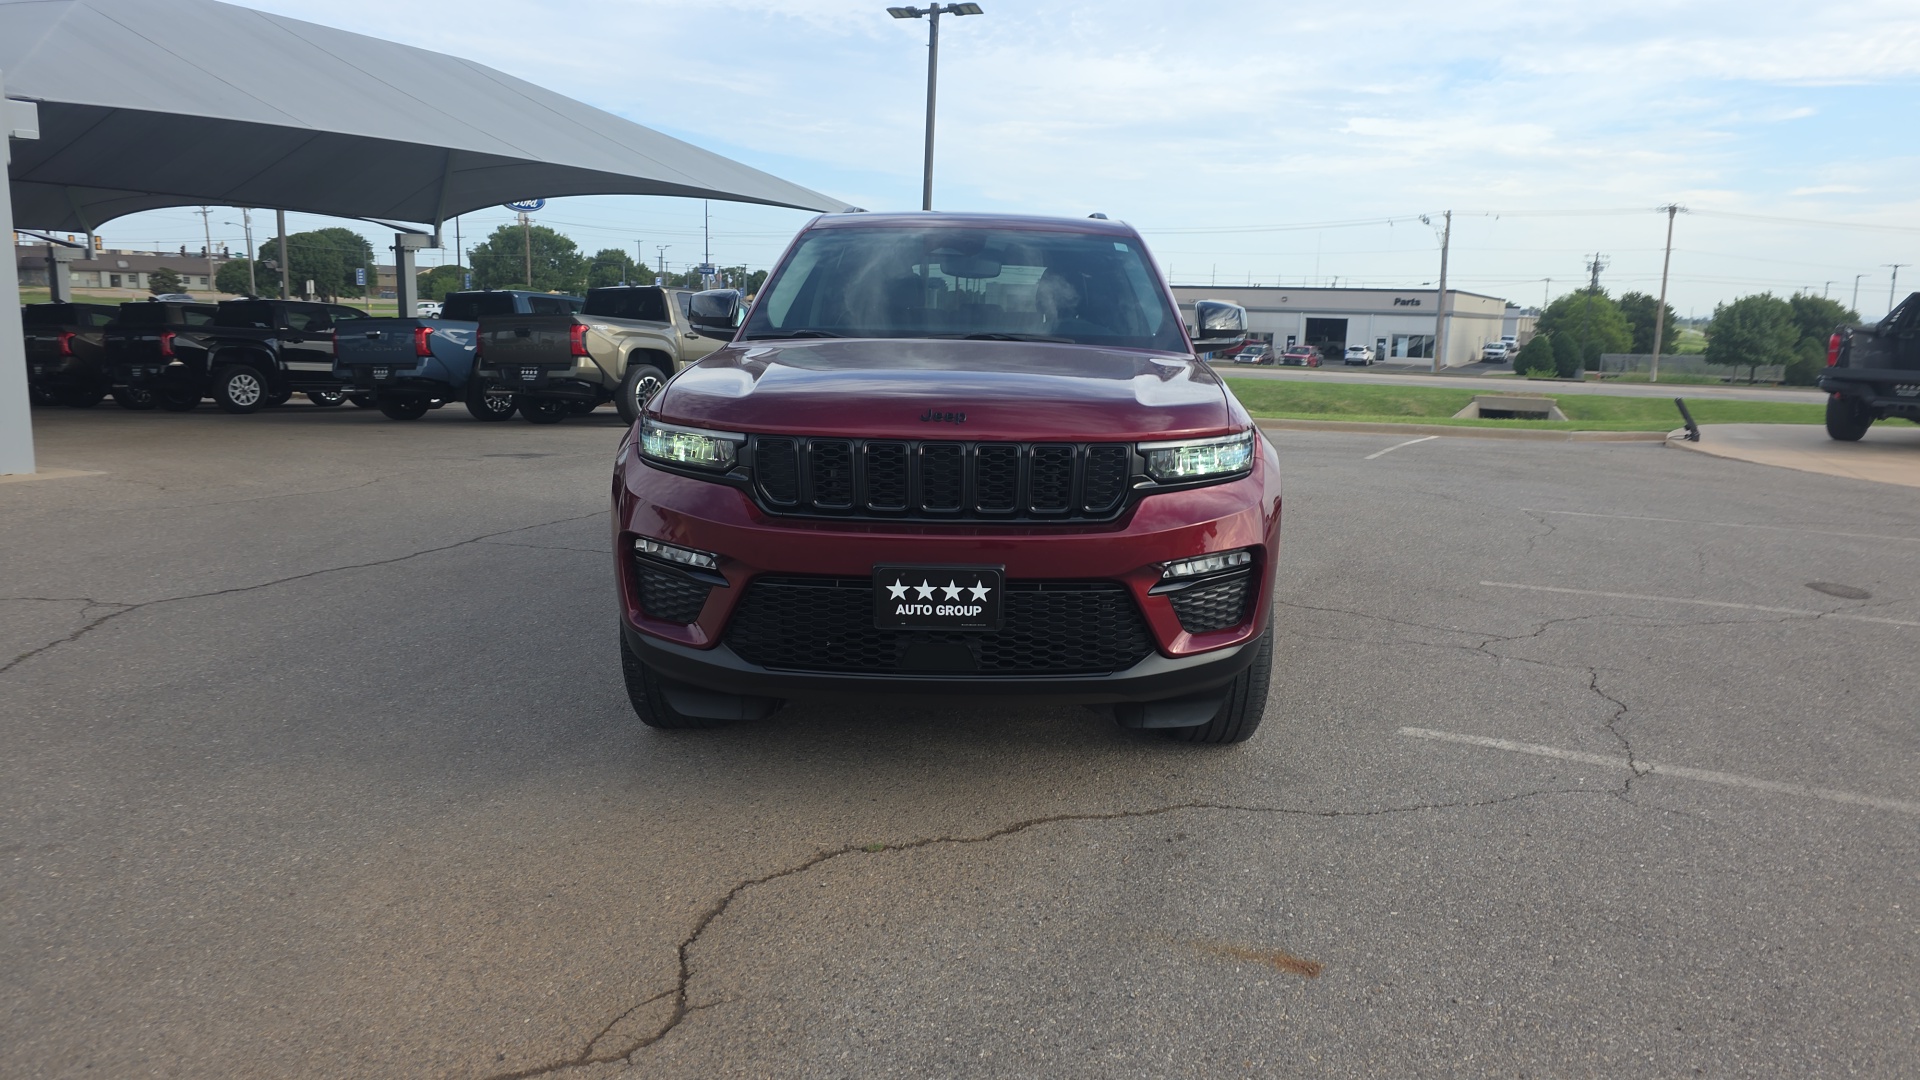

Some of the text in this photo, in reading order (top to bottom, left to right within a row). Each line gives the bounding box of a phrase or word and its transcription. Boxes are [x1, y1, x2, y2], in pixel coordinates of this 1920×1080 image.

[1393, 297, 1421, 306] Parts
[920, 408, 967, 425] Jeep
[895, 604, 982, 617] AUTO GROUP
